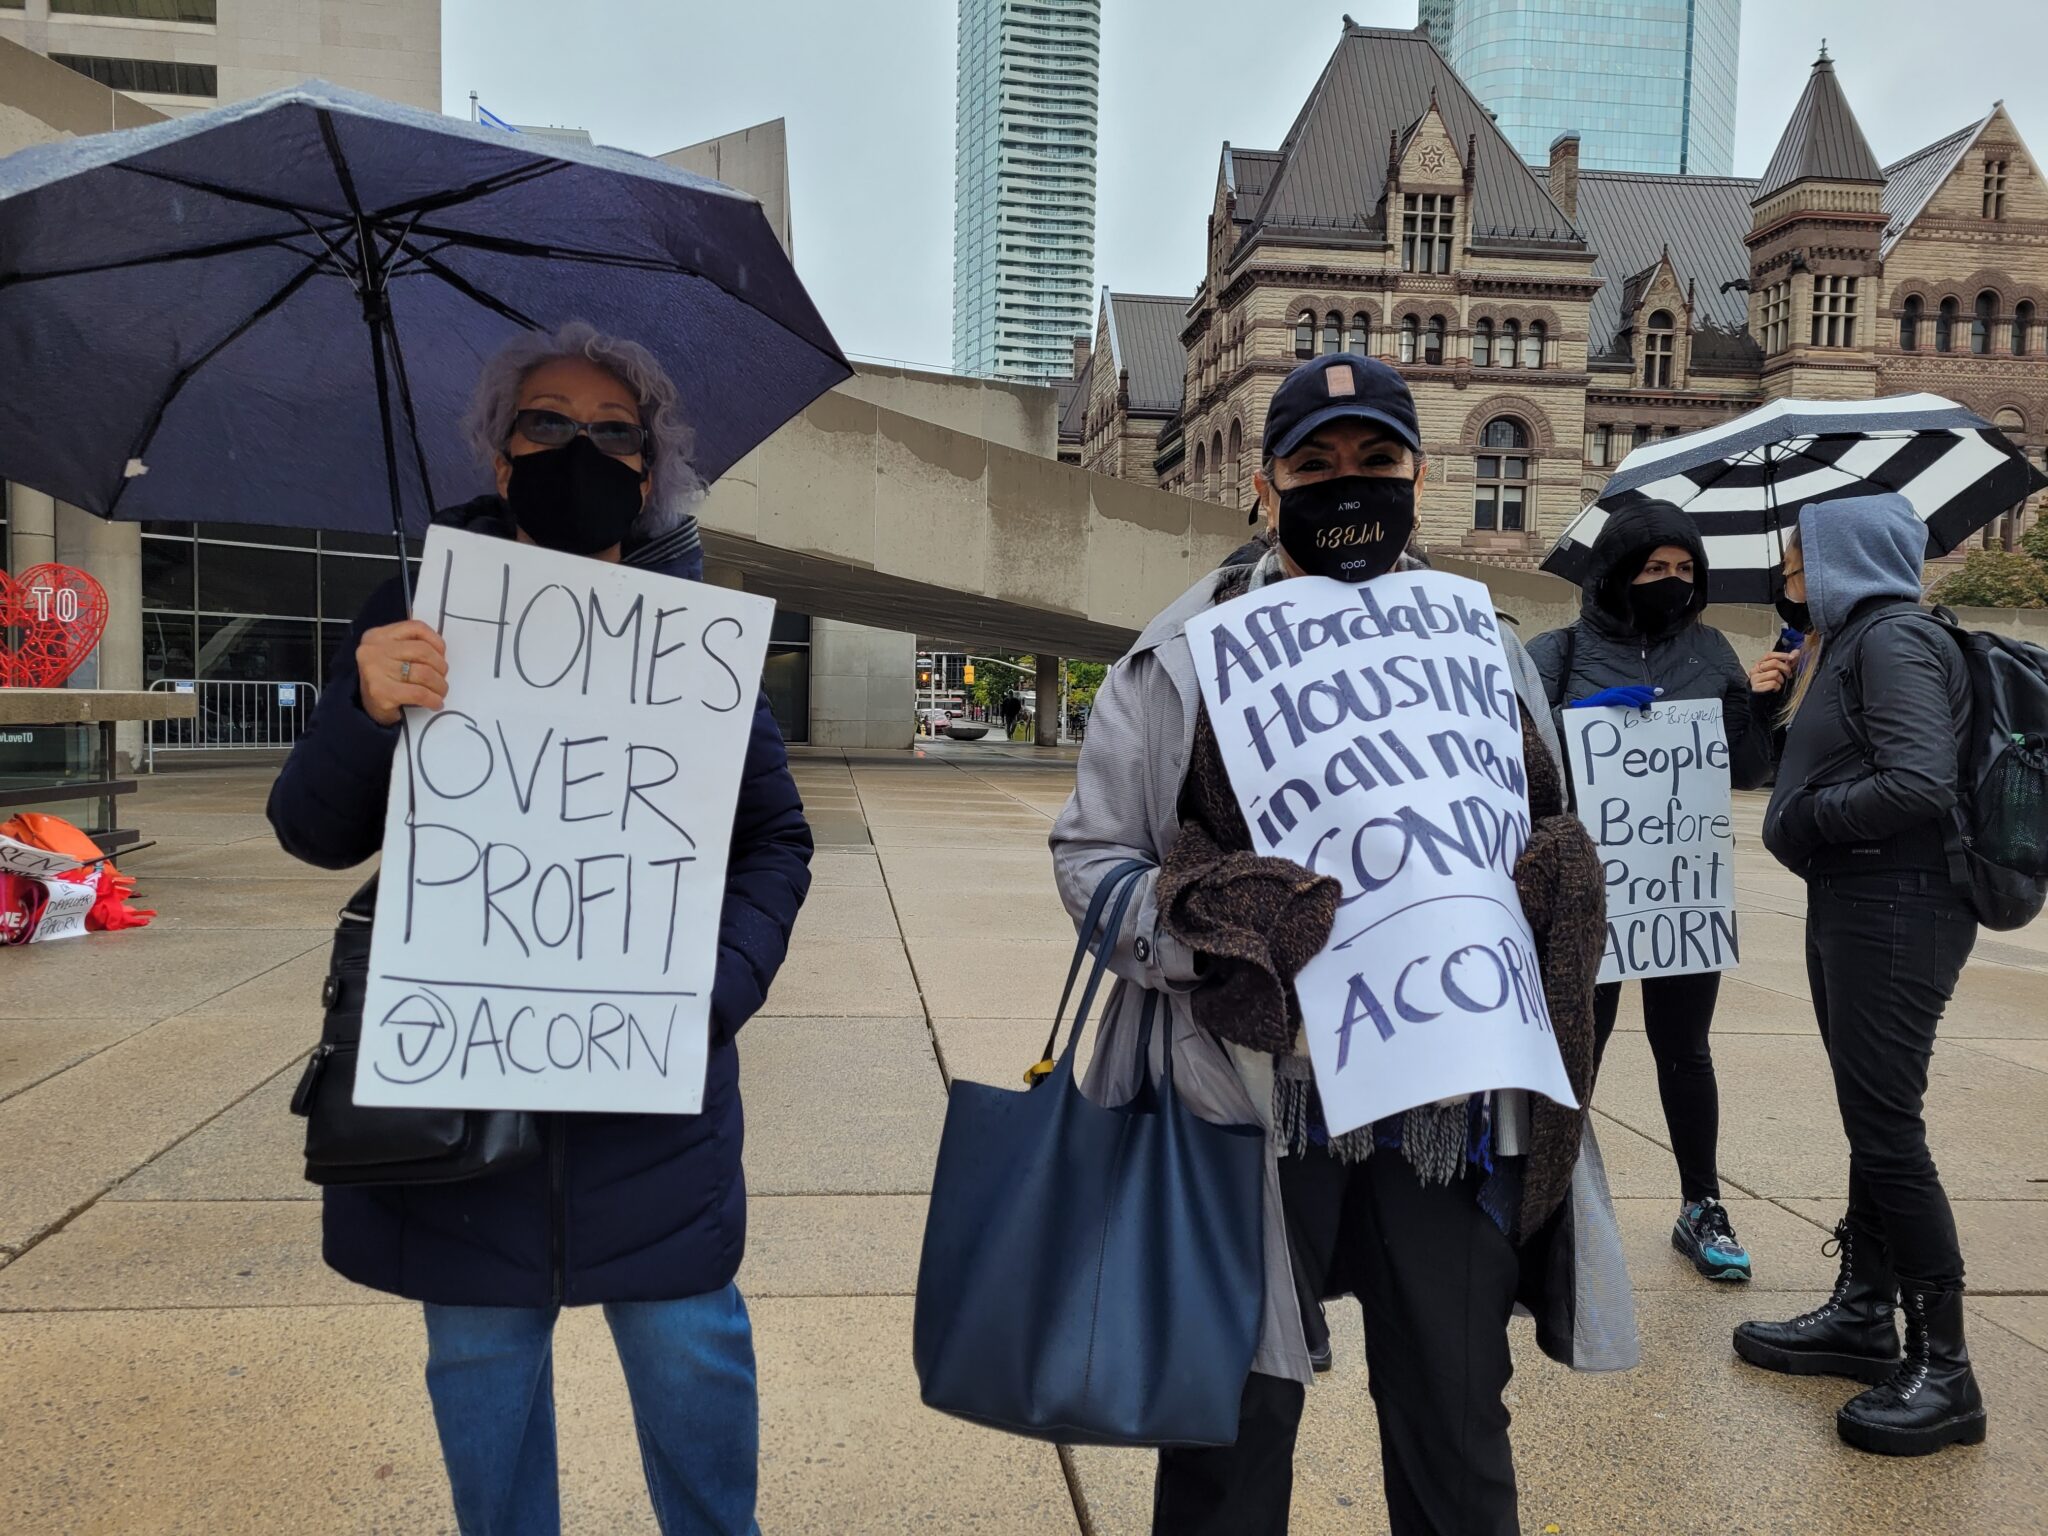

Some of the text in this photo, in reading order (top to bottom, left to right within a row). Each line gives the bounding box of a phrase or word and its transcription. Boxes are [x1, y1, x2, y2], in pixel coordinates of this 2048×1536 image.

[1315, 521, 1384, 549] VIBES
[1337, 501, 1360, 512] ONLY
[1340, 559, 1367, 570] GOOD
[32, 587, 78, 622] TO
[438, 549, 743, 712] HOMES
[1211, 586, 1497, 704] Affordable
[1243, 656, 1519, 772] HOUSING
[418, 710, 696, 849] OVER
[1250, 729, 1526, 848] in all new
[1581, 720, 1729, 796] People
[1601, 797, 1731, 847] Before
[405, 816, 697, 974] PROFIT
[1605, 852, 1725, 904] Profit
[1602, 910, 1740, 975] ACORN
[461, 997, 678, 1079] ACORN
[1335, 937, 1550, 1076] ACORN
